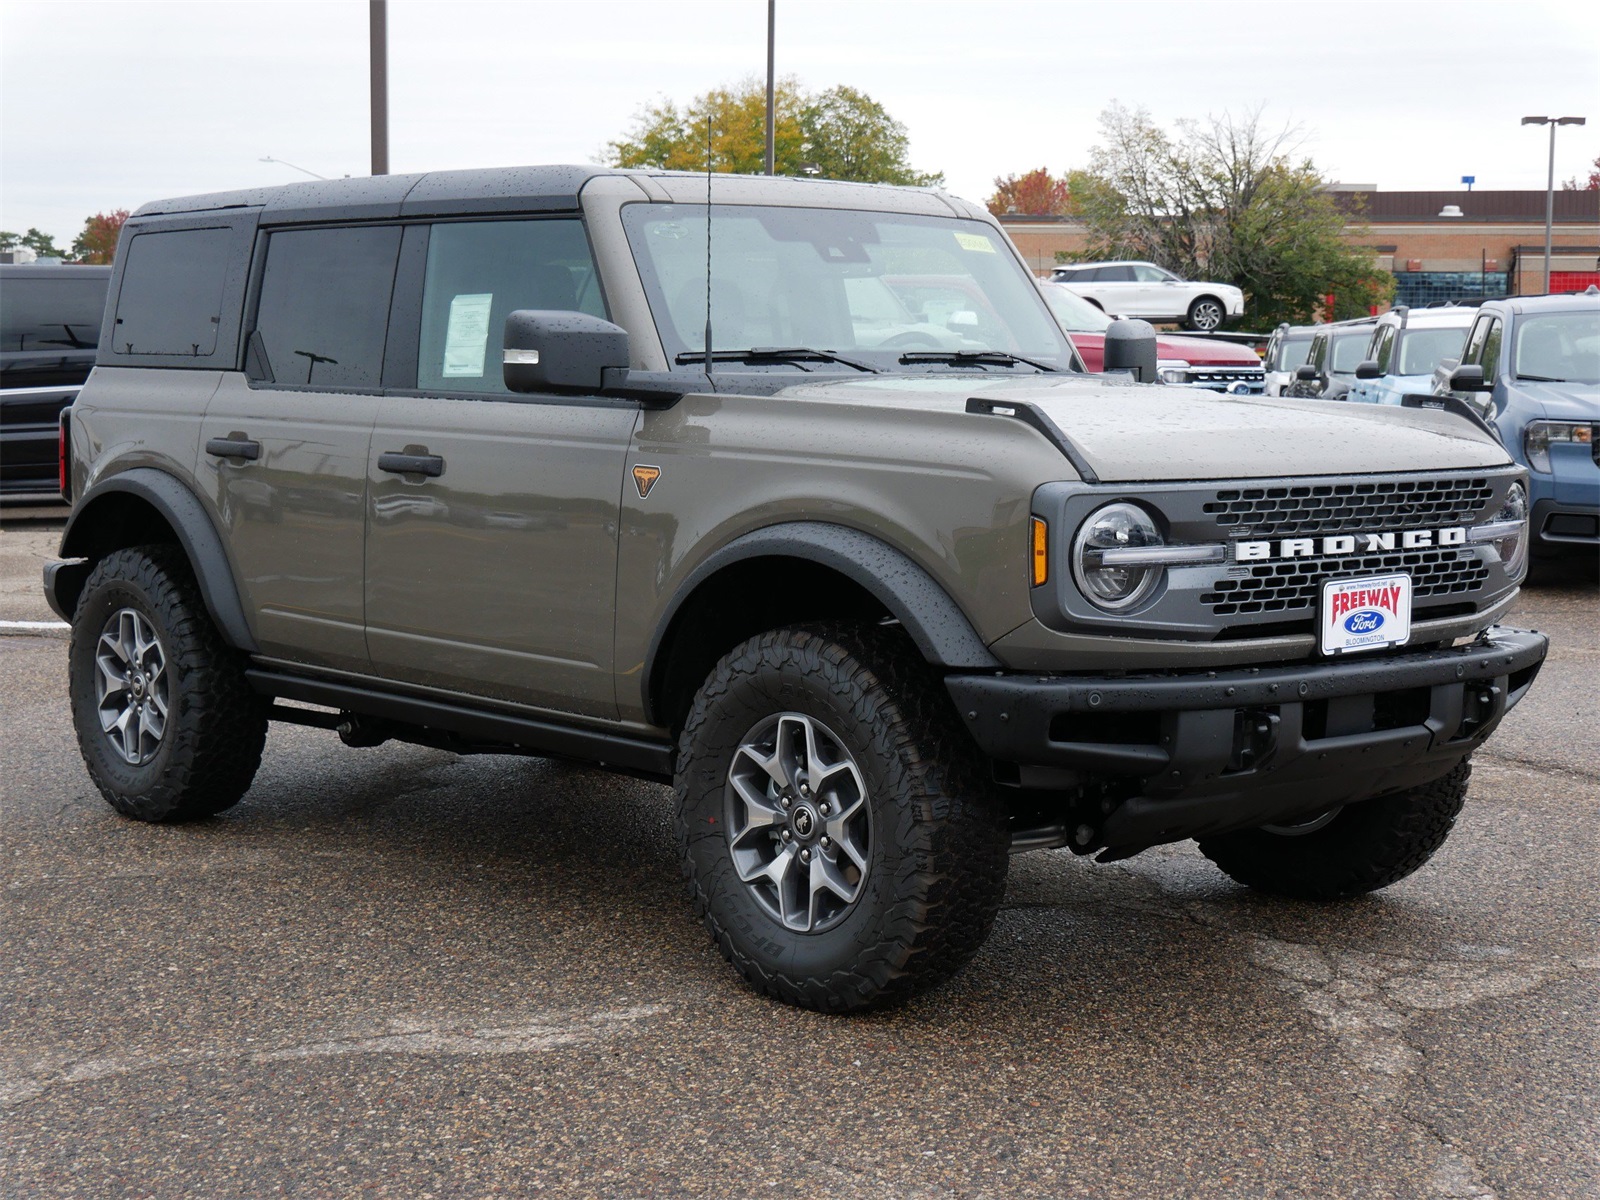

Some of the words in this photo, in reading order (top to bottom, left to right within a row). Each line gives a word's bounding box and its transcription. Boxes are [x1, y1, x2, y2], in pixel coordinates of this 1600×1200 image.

[1236, 527, 1465, 561] BRONCO
[1332, 586, 1401, 628] FREEWAY
[1351, 613, 1378, 631] Ford
[1345, 634, 1385, 646] BLOOMINGTON
